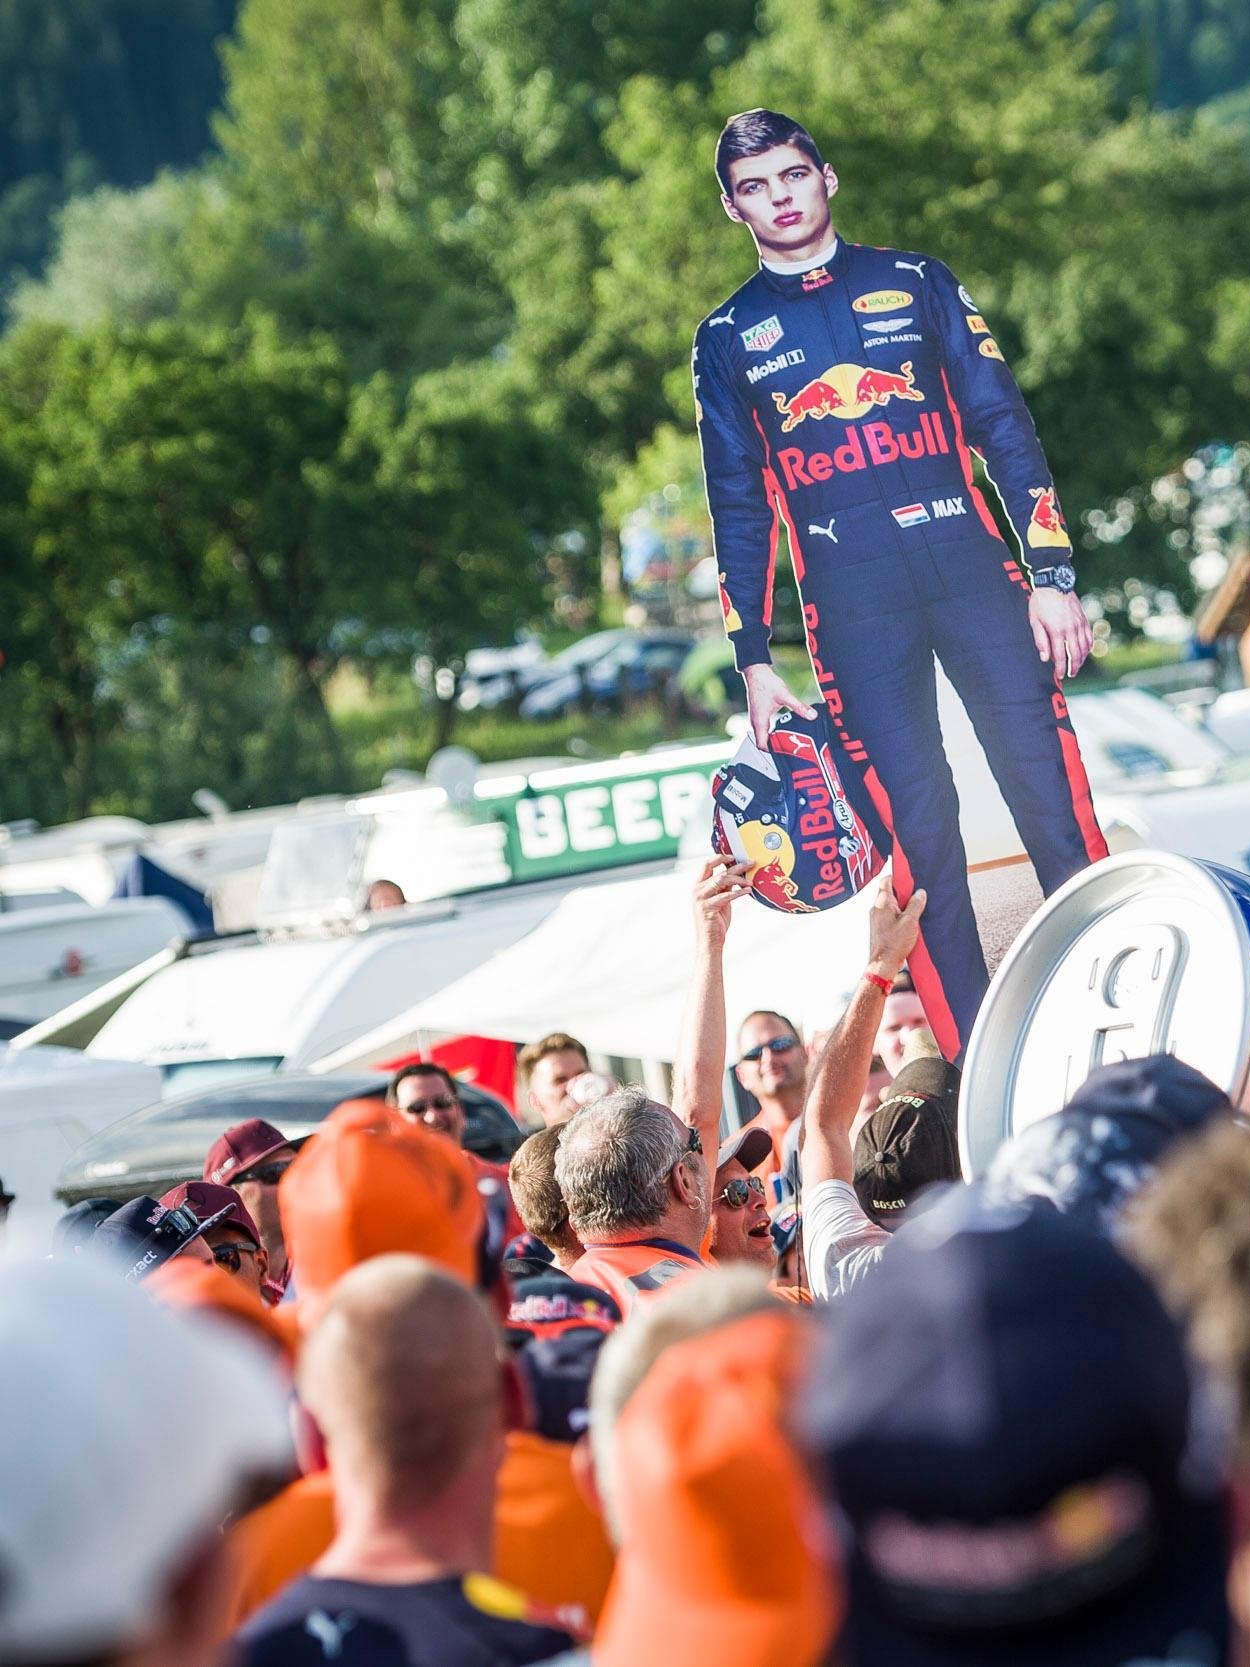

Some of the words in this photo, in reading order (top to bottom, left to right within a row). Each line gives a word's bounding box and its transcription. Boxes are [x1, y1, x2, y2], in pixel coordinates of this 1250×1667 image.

[867, 295, 904, 306] RAUCH
[744, 319, 779, 341] TAG
[746, 328, 781, 349] HEUER
[863, 335, 889, 349] ASTON
[891, 333, 923, 343] MARTIN
[745, 354, 788, 384] Mobil
[931, 496, 967, 519] MAX
[873, 1199, 906, 1210] BOSCH
